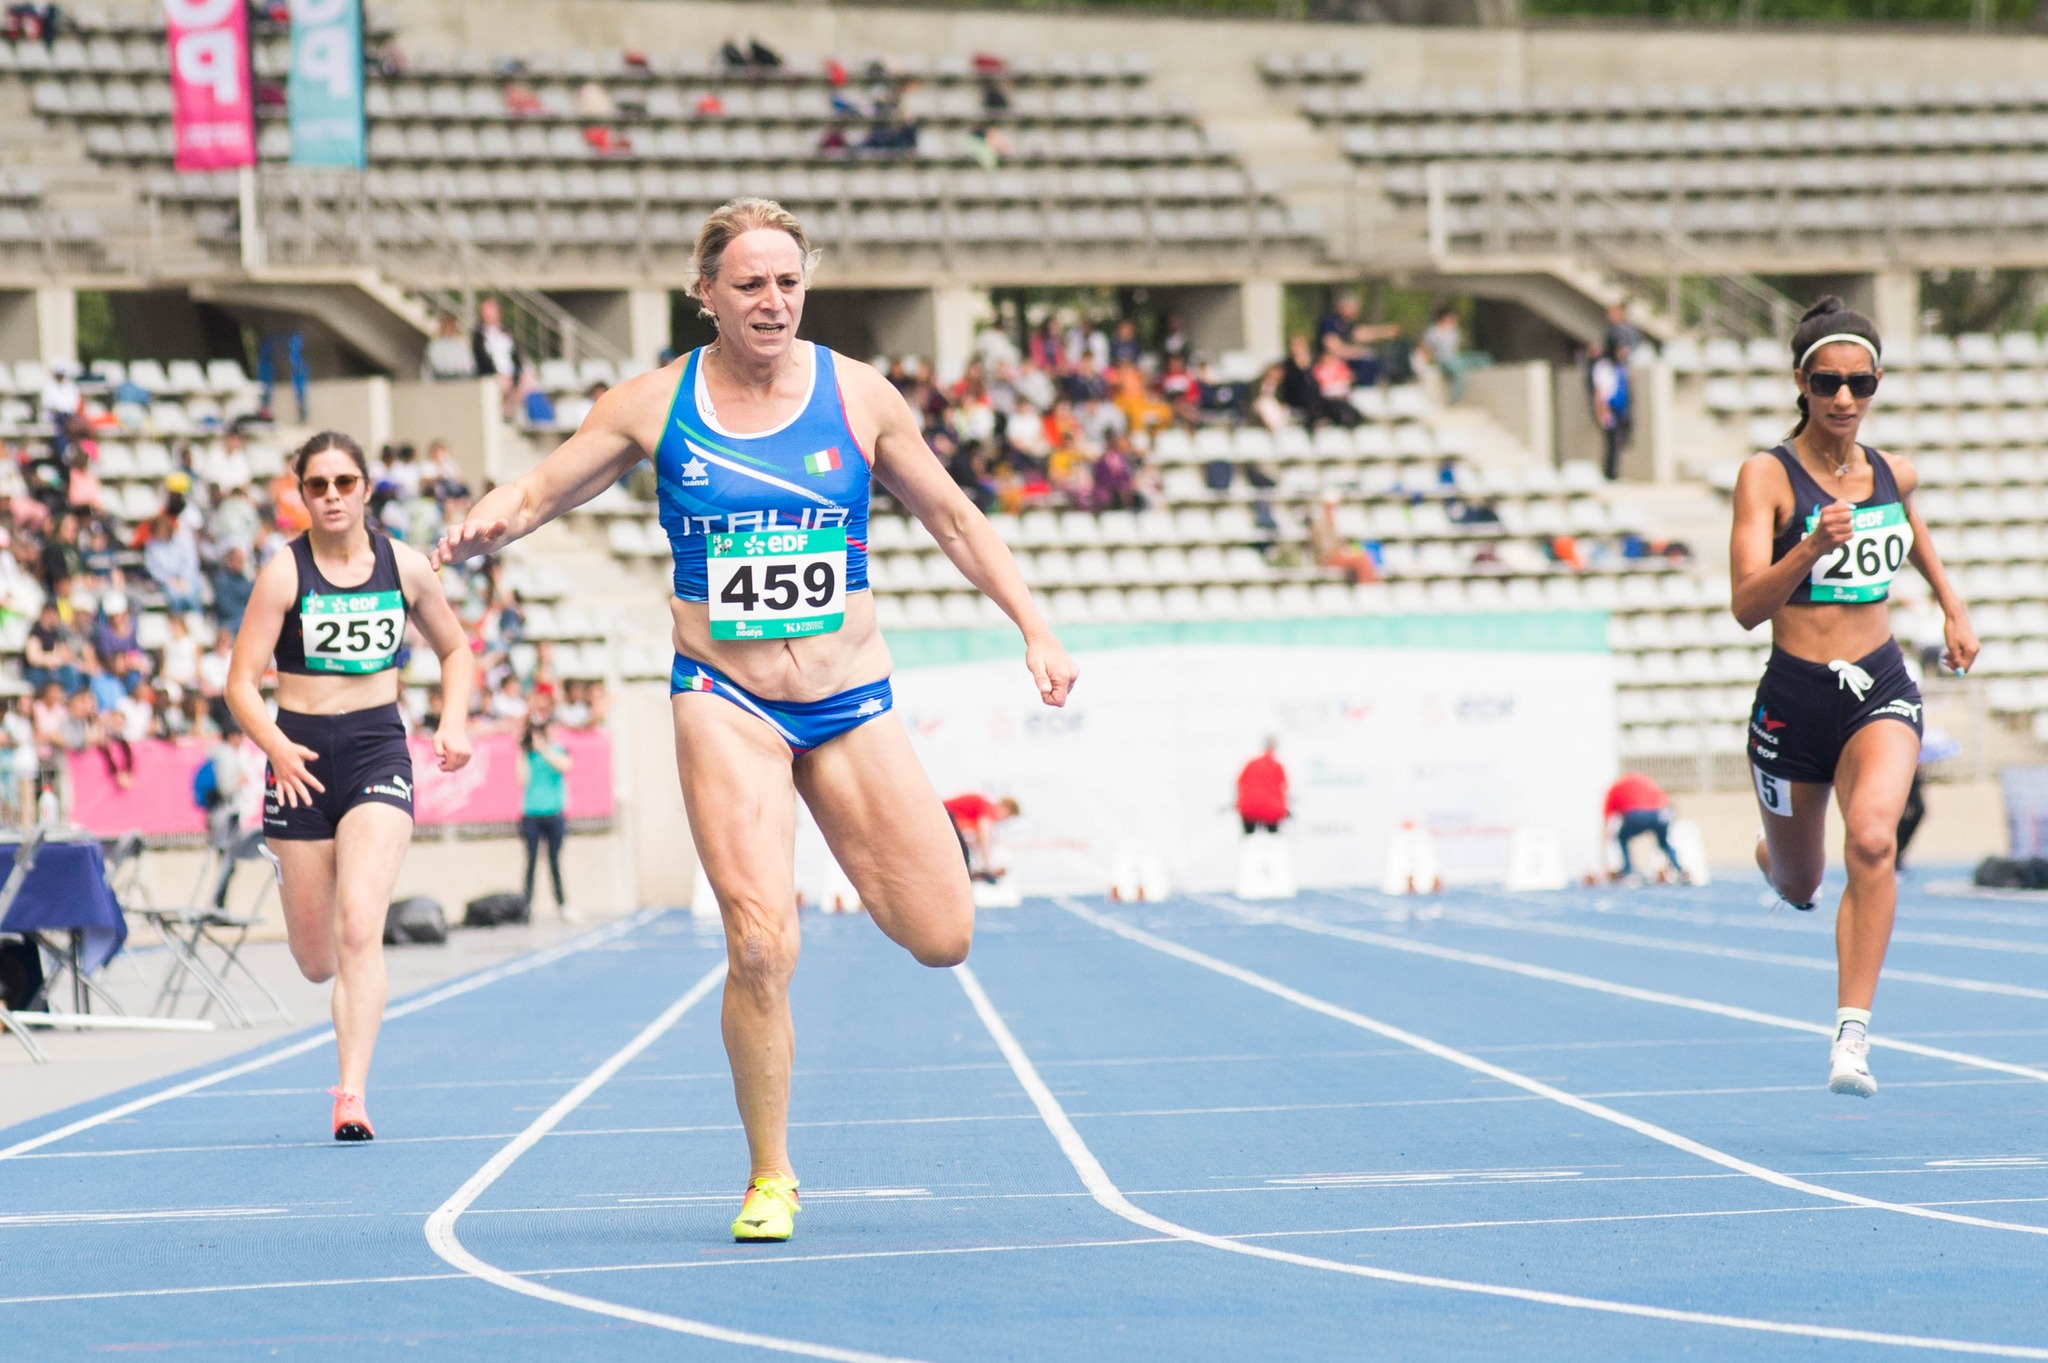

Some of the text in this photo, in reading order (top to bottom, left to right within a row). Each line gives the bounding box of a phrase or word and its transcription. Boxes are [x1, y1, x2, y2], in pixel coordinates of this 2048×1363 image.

[683, 508, 850, 536] ITALIA
[1823, 534, 1904, 579] 260
[720, 561, 835, 611] 459
[315, 618, 396, 653] 253
[1761, 772, 1779, 809] 5
